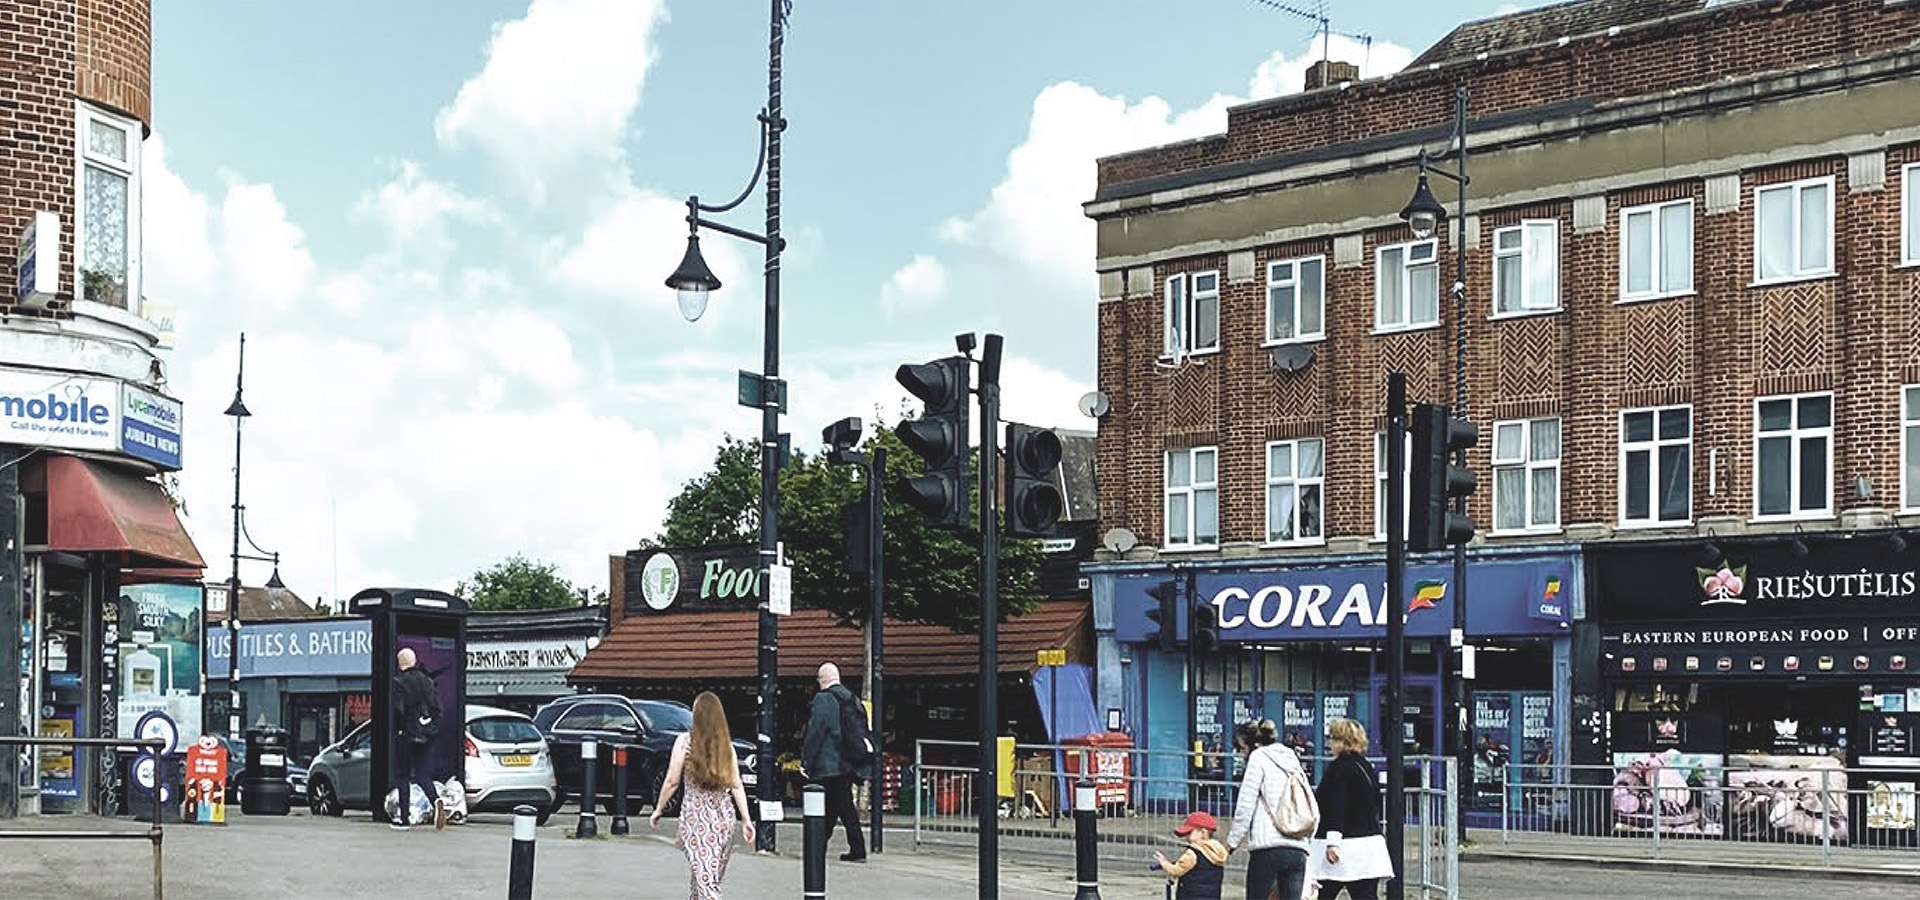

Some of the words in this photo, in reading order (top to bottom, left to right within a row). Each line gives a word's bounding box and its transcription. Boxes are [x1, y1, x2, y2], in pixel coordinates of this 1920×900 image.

[0, 394, 109, 424] mobile
[11, 421, 29, 430] Call
[31, 423, 46, 432] the
[48, 425, 74, 435] world
[76, 426, 88, 436] for
[91, 428, 109, 438] less
[125, 426, 156, 448] JUBILEE
[157, 436, 179, 456] NEWS
[1539, 603, 1561, 616] CORAL
[143, 616, 165, 627] SILKY
[1622, 632, 1696, 644] EASTERN
[1702, 630, 1793, 643] EUROPEAN
[1801, 628, 1849, 642] FOOD
[1882, 627, 1918, 640] OFF
[240, 633, 284, 657] TILES
[288, 633, 304, 656] &
[1196, 695, 1219, 705] COUNT
[1324, 696, 1349, 706] COUNT
[1523, 696, 1551, 706] COUNT
[1196, 705, 1217, 715] DOWN
[1523, 707, 1548, 717] DOWN
[1523, 717, 1545, 728] WITH
[1196, 724, 1223, 733] BOOSTS
